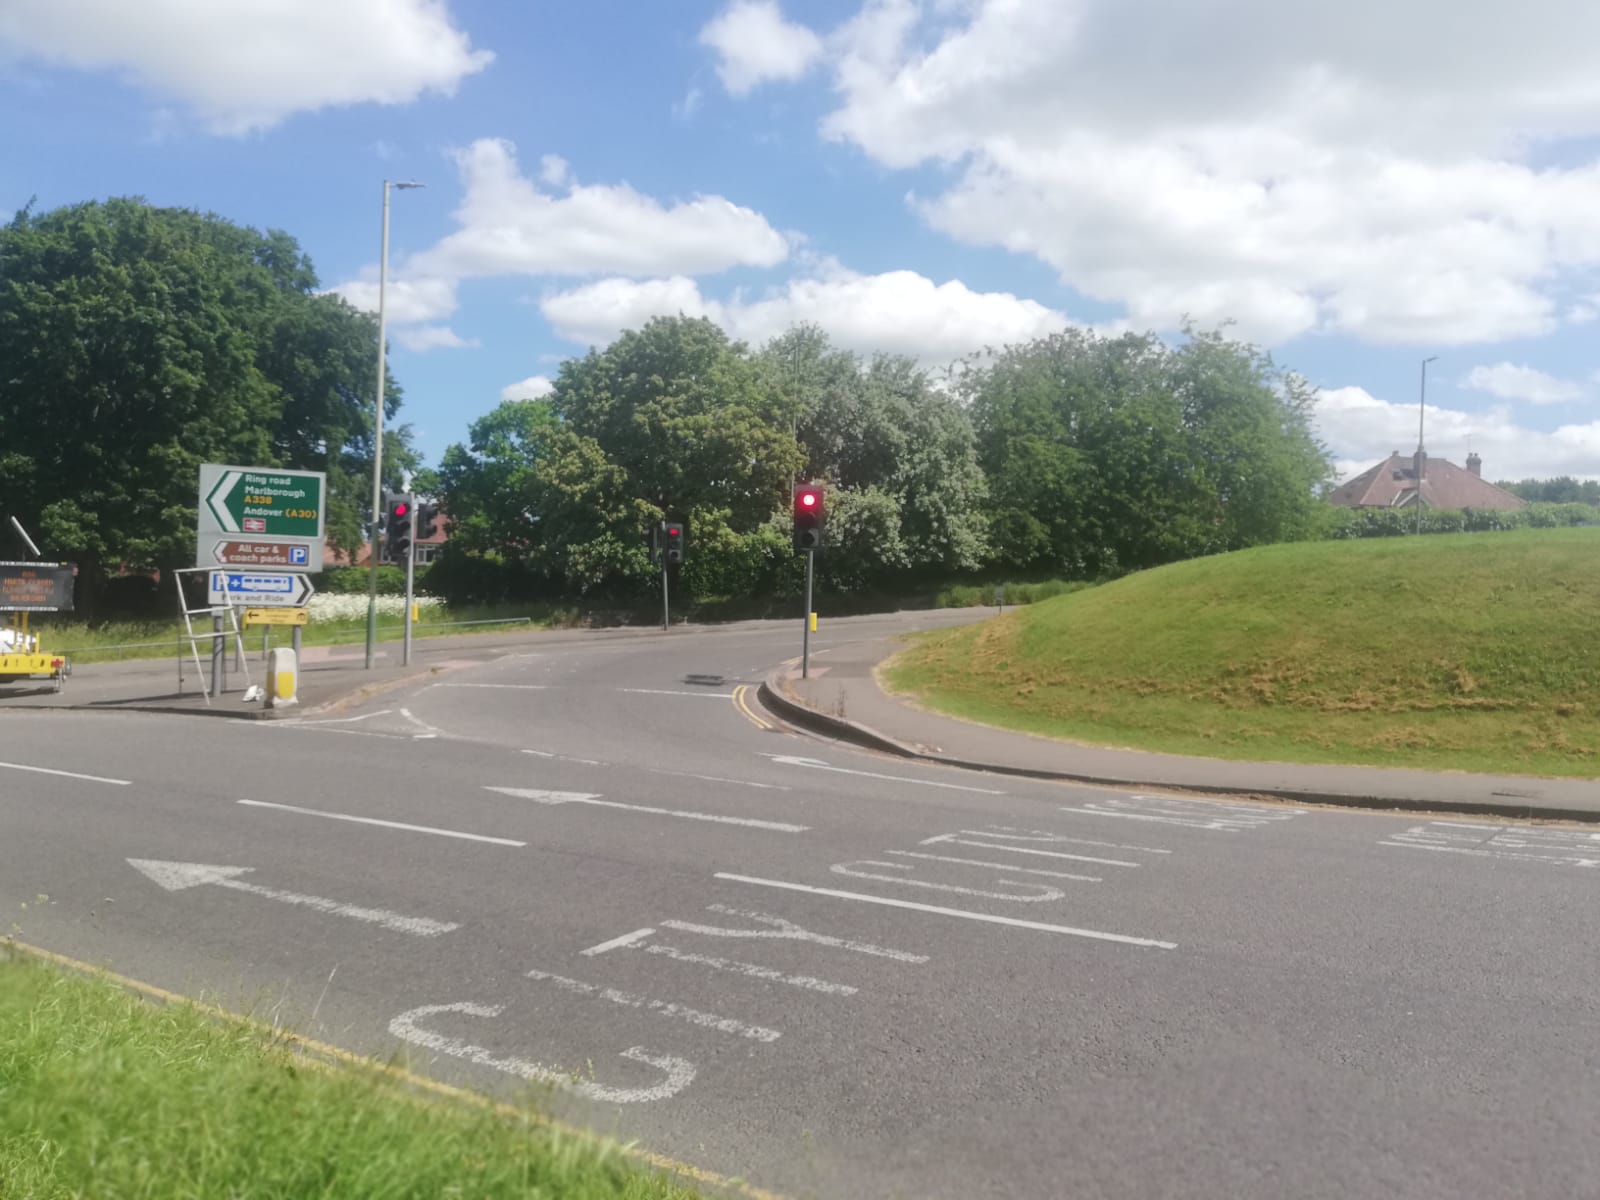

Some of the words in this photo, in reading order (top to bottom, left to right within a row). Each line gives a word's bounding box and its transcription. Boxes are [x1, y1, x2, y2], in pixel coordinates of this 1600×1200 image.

[245, 474, 267, 485] Ring
[269, 476, 291, 485] road
[244, 486, 305, 498] Marlborough
[243, 507, 283, 517] Andover
[238, 544, 251, 553] All
[229, 552, 258, 561] coach
[260, 554, 287, 563] parks
[387, 903, 931, 1104] CITY
